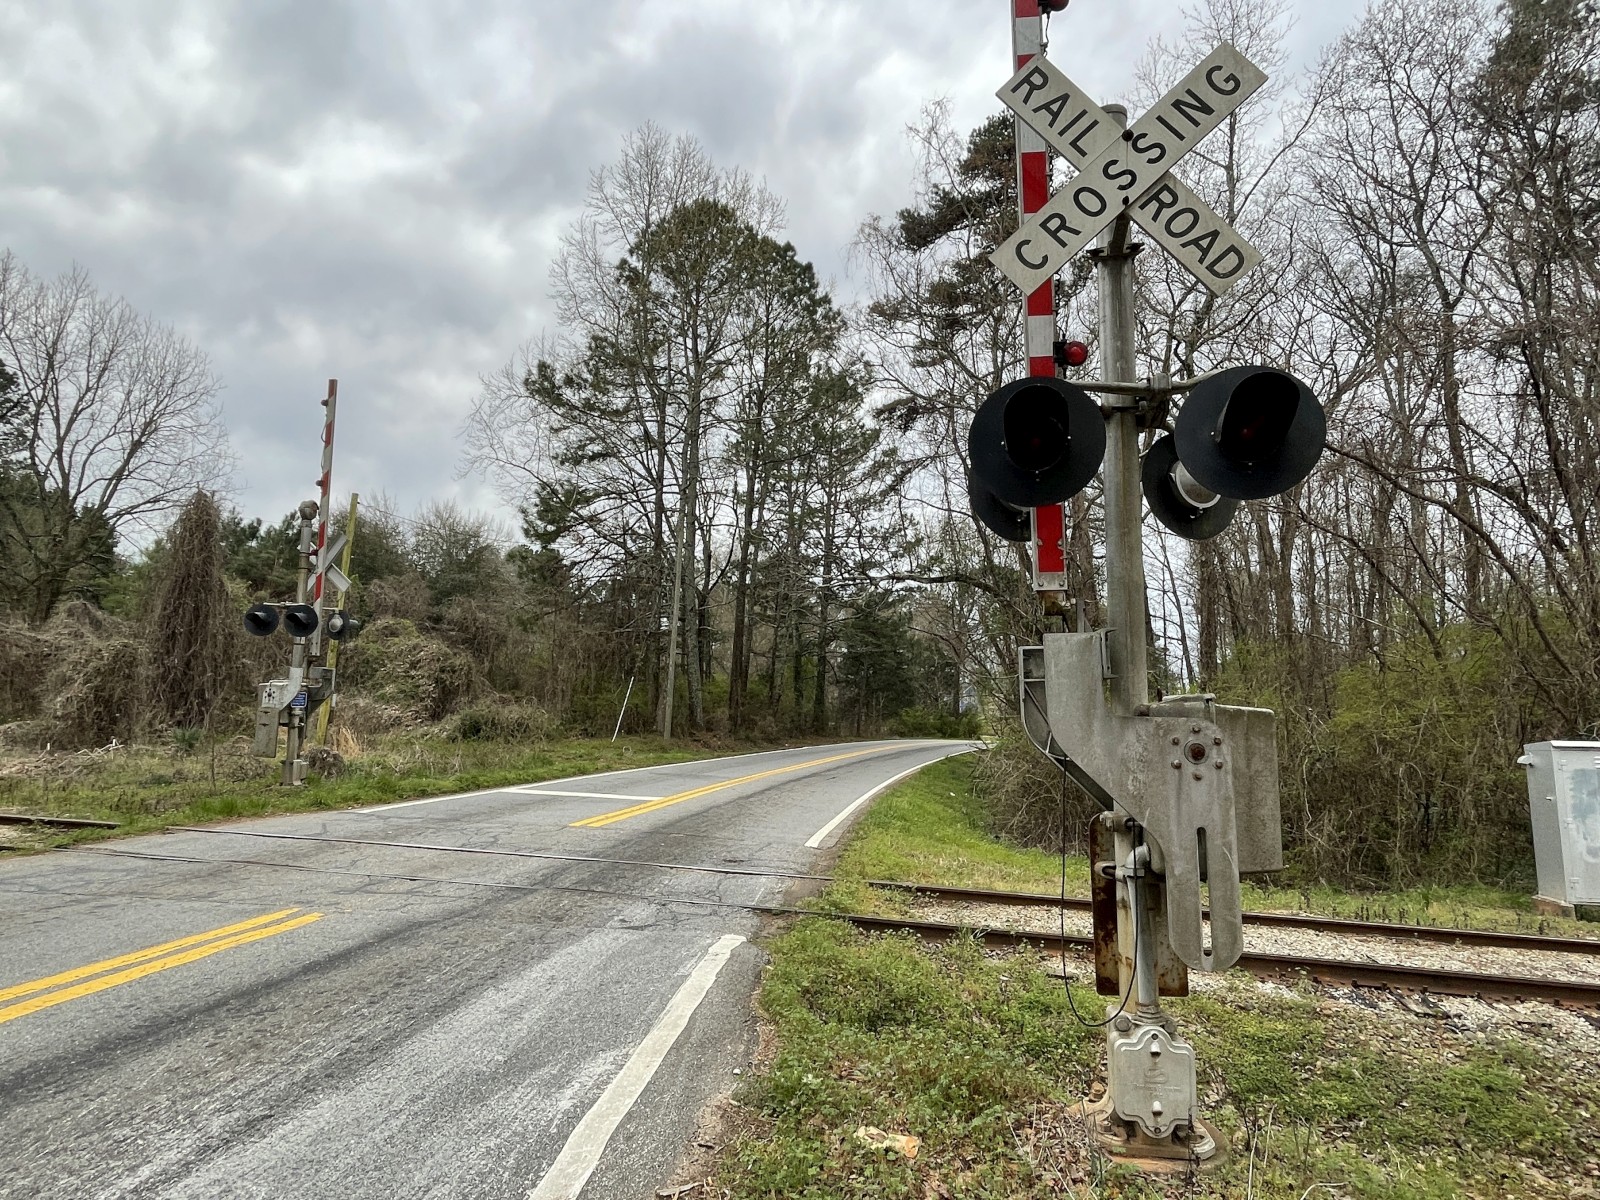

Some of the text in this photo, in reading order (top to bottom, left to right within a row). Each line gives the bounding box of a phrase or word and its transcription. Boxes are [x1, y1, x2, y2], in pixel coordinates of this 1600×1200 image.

[1010, 65, 1245, 279] RAIL ROAD
[1015, 65, 1241, 270] CROSSING
